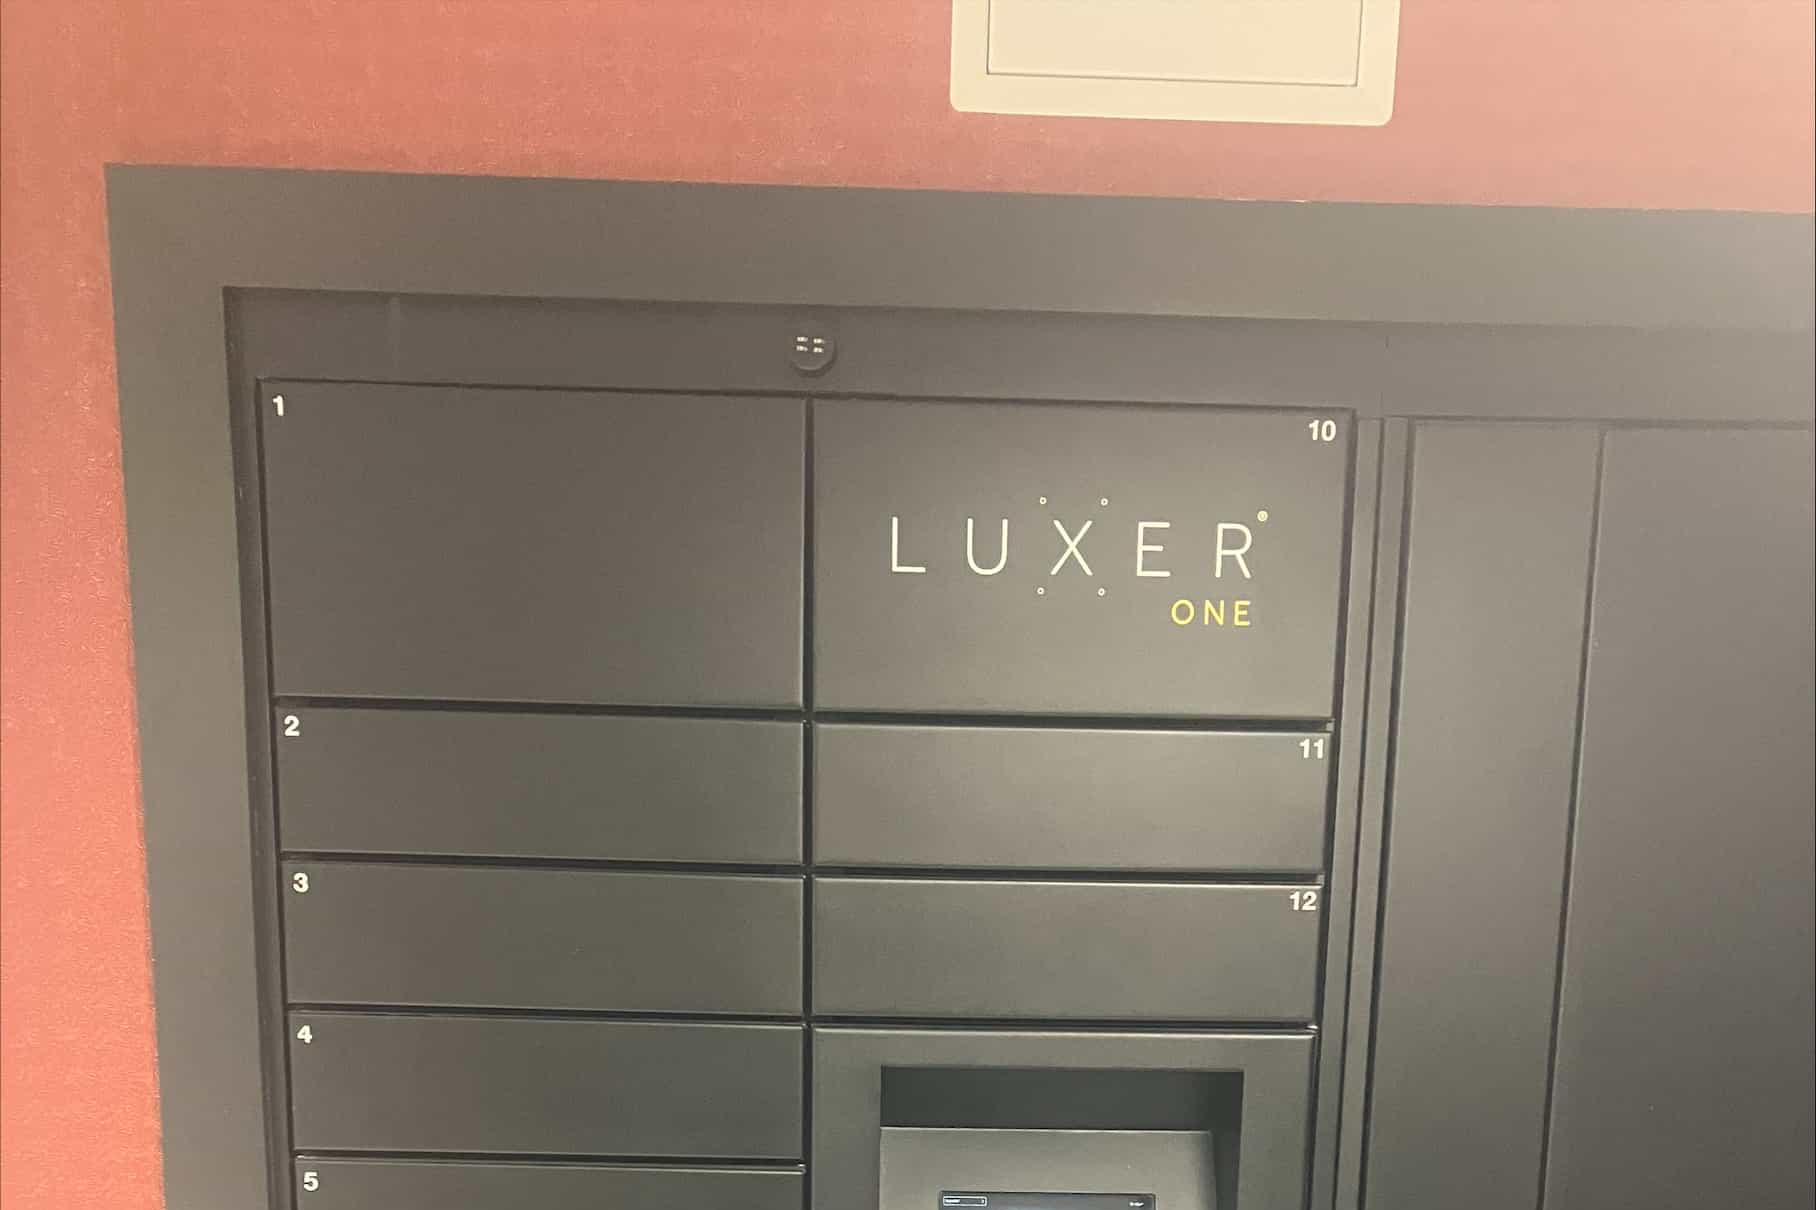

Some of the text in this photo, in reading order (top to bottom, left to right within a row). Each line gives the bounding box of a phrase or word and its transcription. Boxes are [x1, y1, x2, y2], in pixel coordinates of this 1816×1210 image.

[272, 395, 284, 417] 1
[1308, 419, 1337, 442] 10
[1171, 599, 1251, 626] ONE
[284, 715, 300, 737] 2
[1298, 738, 1325, 759] 11
[292, 872, 309, 893] 3
[1289, 891, 1318, 911] 12
[296, 1025, 313, 1044] 4
[303, 1171, 319, 1192] 5
